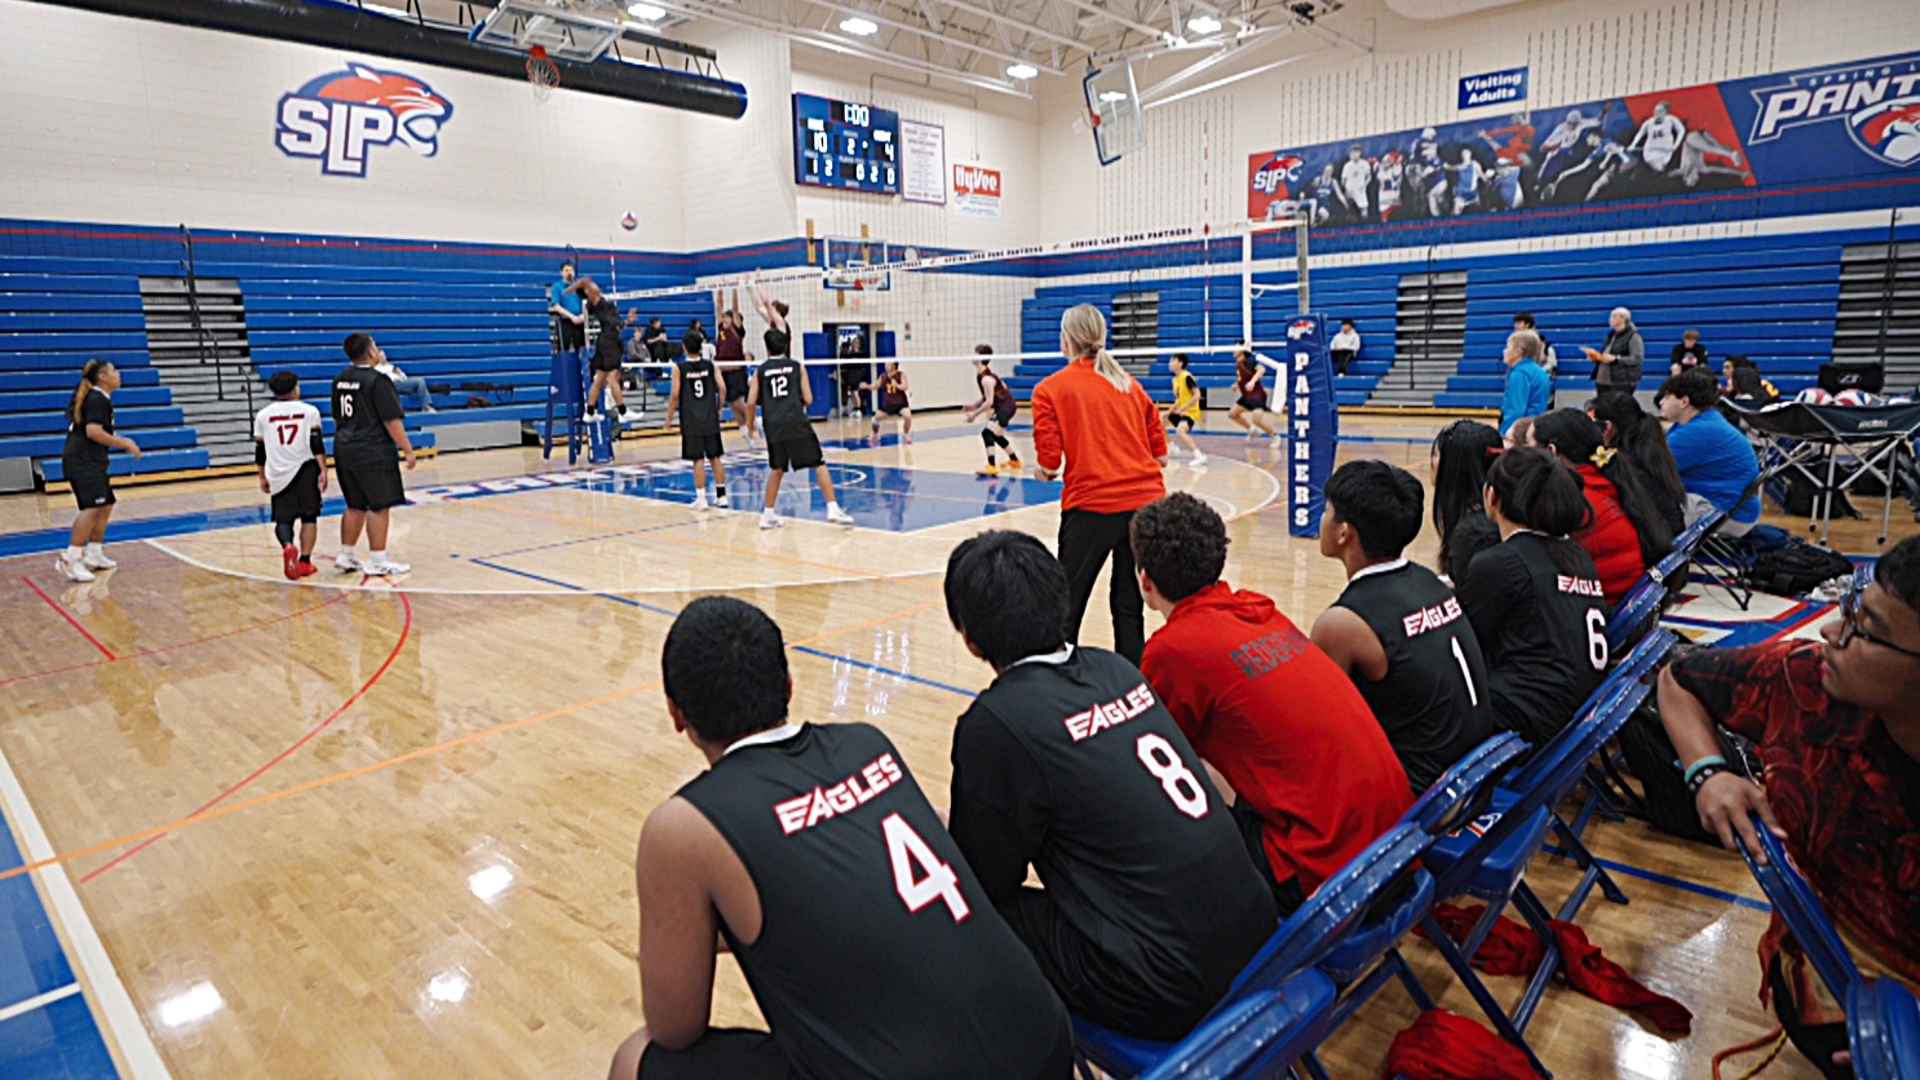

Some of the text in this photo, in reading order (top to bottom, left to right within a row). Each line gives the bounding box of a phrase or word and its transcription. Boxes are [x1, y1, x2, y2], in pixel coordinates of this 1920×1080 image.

[1464, 72, 1522, 92] Visiting
[1809, 65, 1891, 87] SPRING
[1467, 87, 1517, 105] Adults
[277, 93, 397, 177] SLP
[1253, 168, 1286, 193] SLP
[1070, 239, 1099, 249] SPRING
[1123, 233, 1145, 242] PARK
[1147, 227, 1192, 240] PANTHERS
[693, 379, 704, 399] 9
[770, 375, 789, 398] 12
[340, 393, 354, 418] 16
[277, 424, 299, 445] 17
[1294, 353, 1311, 526] PANTHERS
[1402, 596, 1462, 638] EAGLES
[1585, 607, 1609, 671] 6
[1450, 635, 1478, 708] 1
[1063, 682, 1156, 742] EAGLES
[1135, 732, 1209, 820] 8
[772, 752, 904, 836] EAGLES
[880, 811, 973, 925] 4
